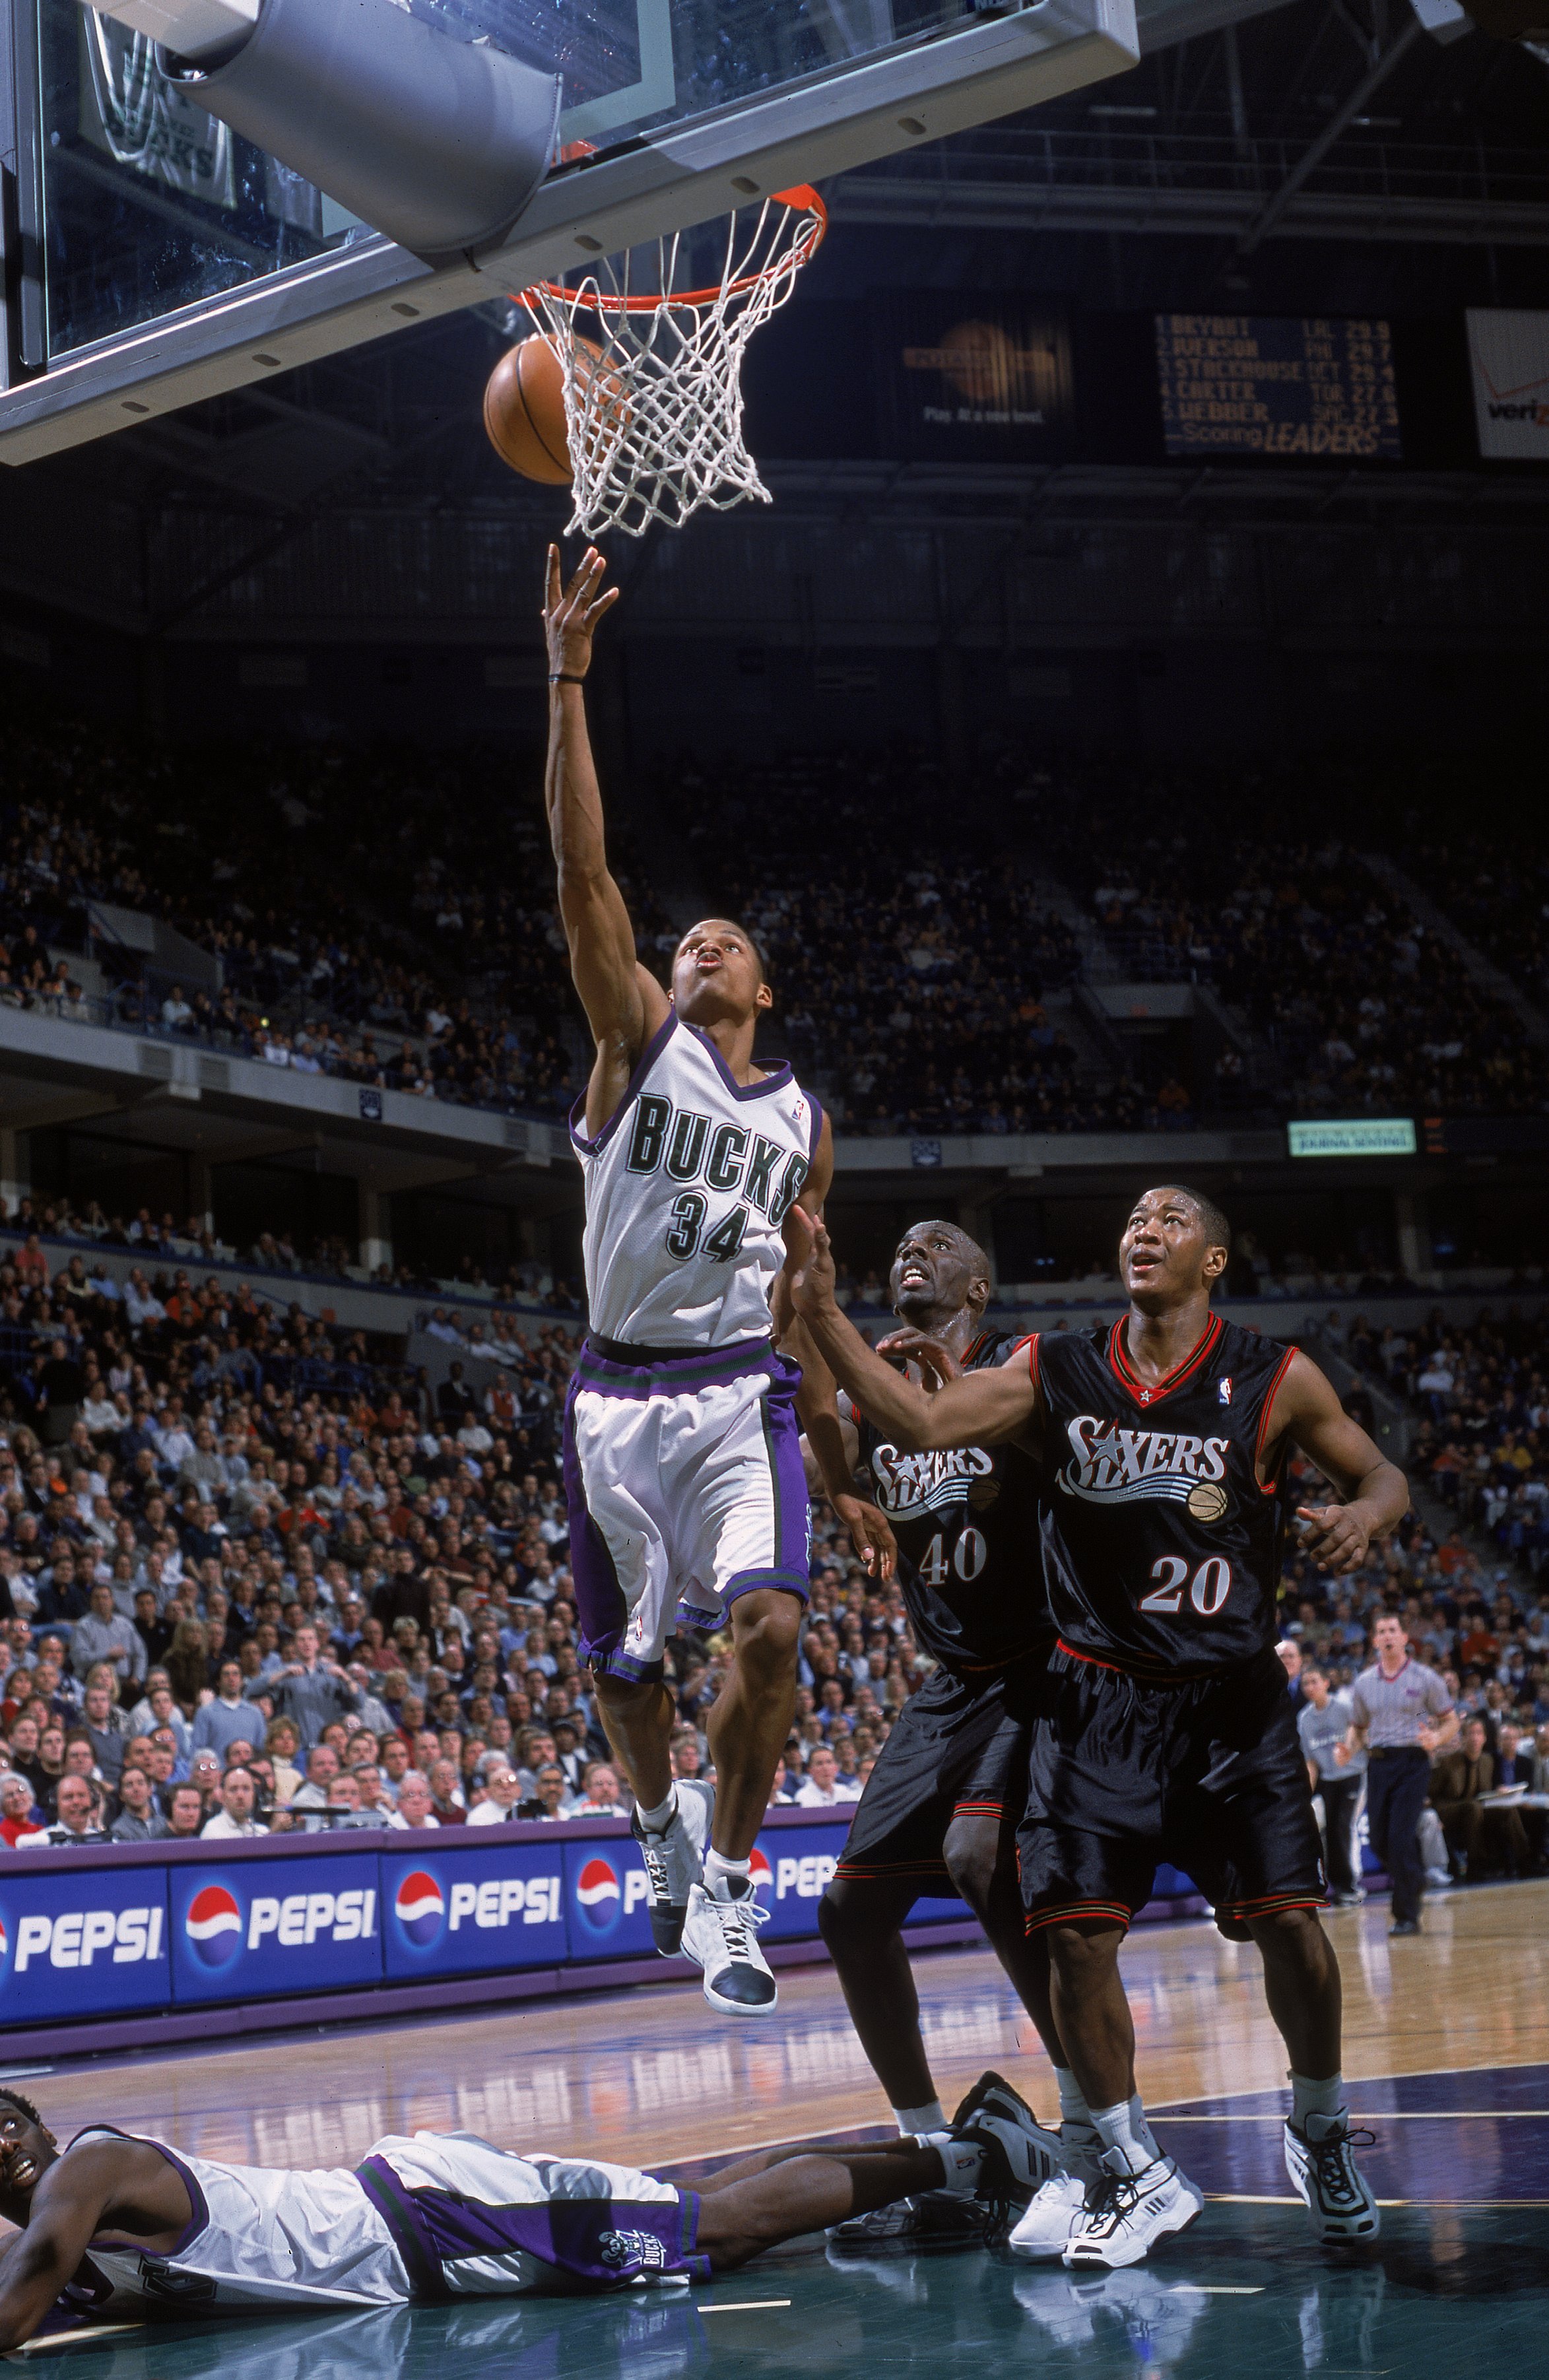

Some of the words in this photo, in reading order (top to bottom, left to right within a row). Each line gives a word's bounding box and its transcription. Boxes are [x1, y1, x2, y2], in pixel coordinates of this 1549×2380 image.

[1182, 422, 1263, 448] Scoring
[1264, 423, 1381, 454] LEADERS
[626, 1092, 810, 1227] BUCKS
[666, 1192, 749, 1263] 34
[919, 1527, 987, 1587] 40
[1139, 1554, 1232, 1616] 20
[449, 1876, 560, 1931] PEPSI
[775, 1855, 840, 1900] PEP
[15, 1906, 163, 1972] PEPSI
[247, 1889, 376, 1950] PEPSI
